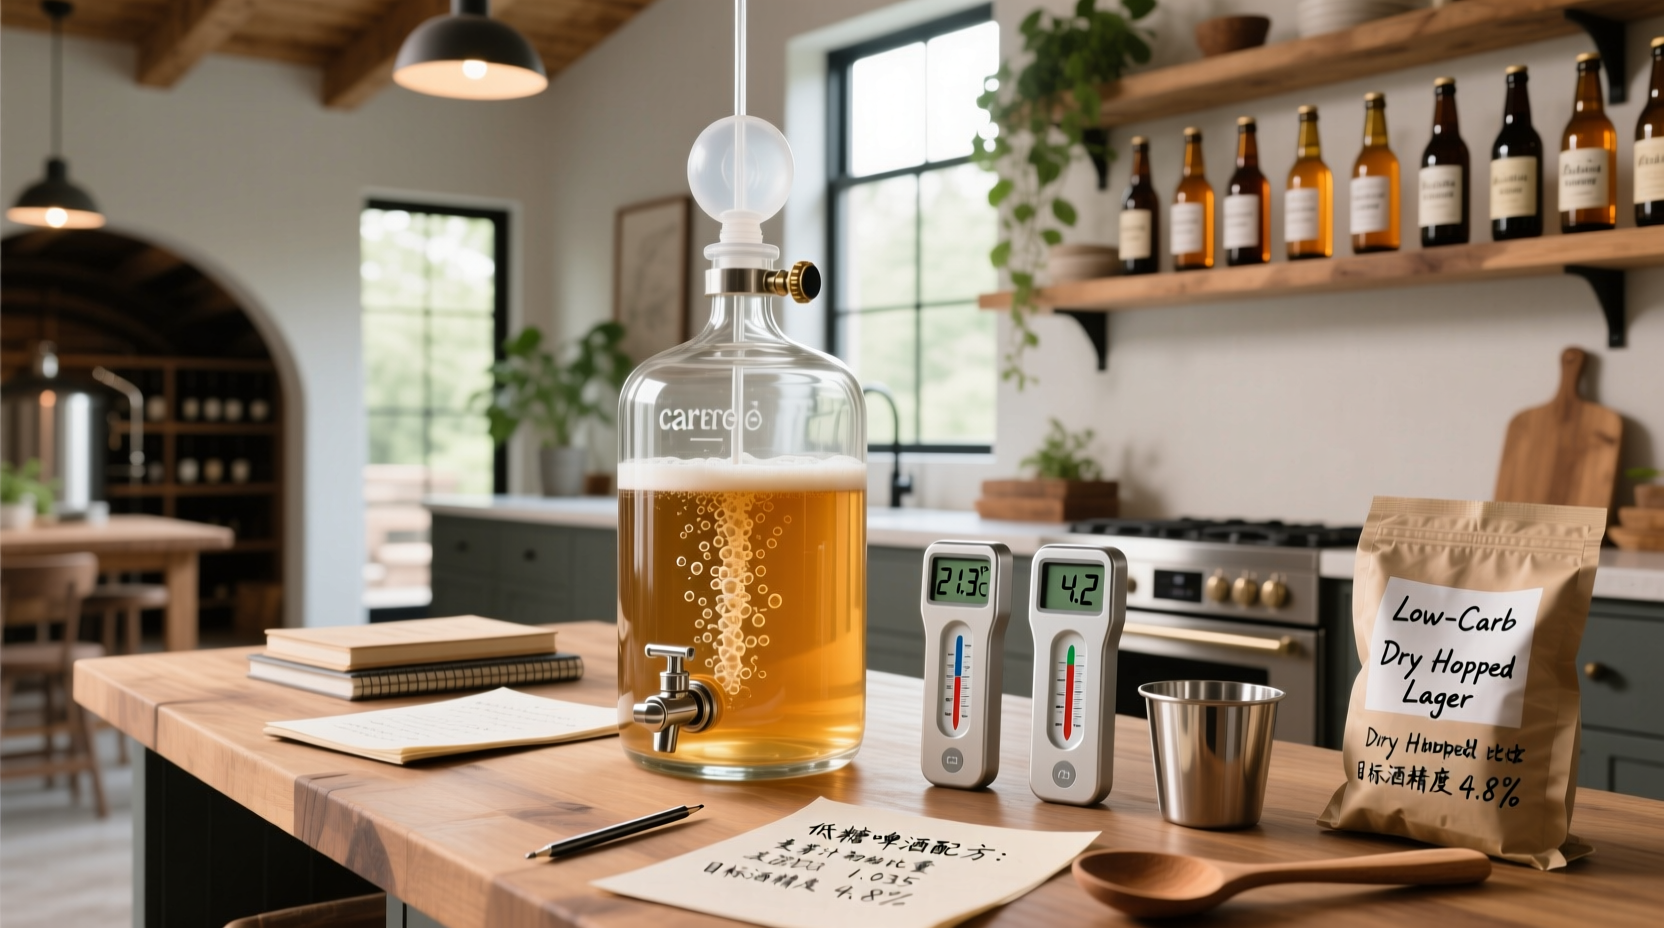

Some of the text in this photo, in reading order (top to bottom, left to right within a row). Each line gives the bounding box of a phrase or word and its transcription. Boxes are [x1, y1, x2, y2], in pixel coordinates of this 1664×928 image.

[1062, 574, 1099, 606] 4.2
[1392, 595, 1517, 632] Low-Carb
[1380, 640, 1516, 685] Dry Hopped
[1402, 679, 1473, 719] Lager
[1358, 761, 1521, 808] 目标酒精度 4.8%
[835, 885, 914, 906] 4.8%
[848, 868, 921, 886] 1.035
